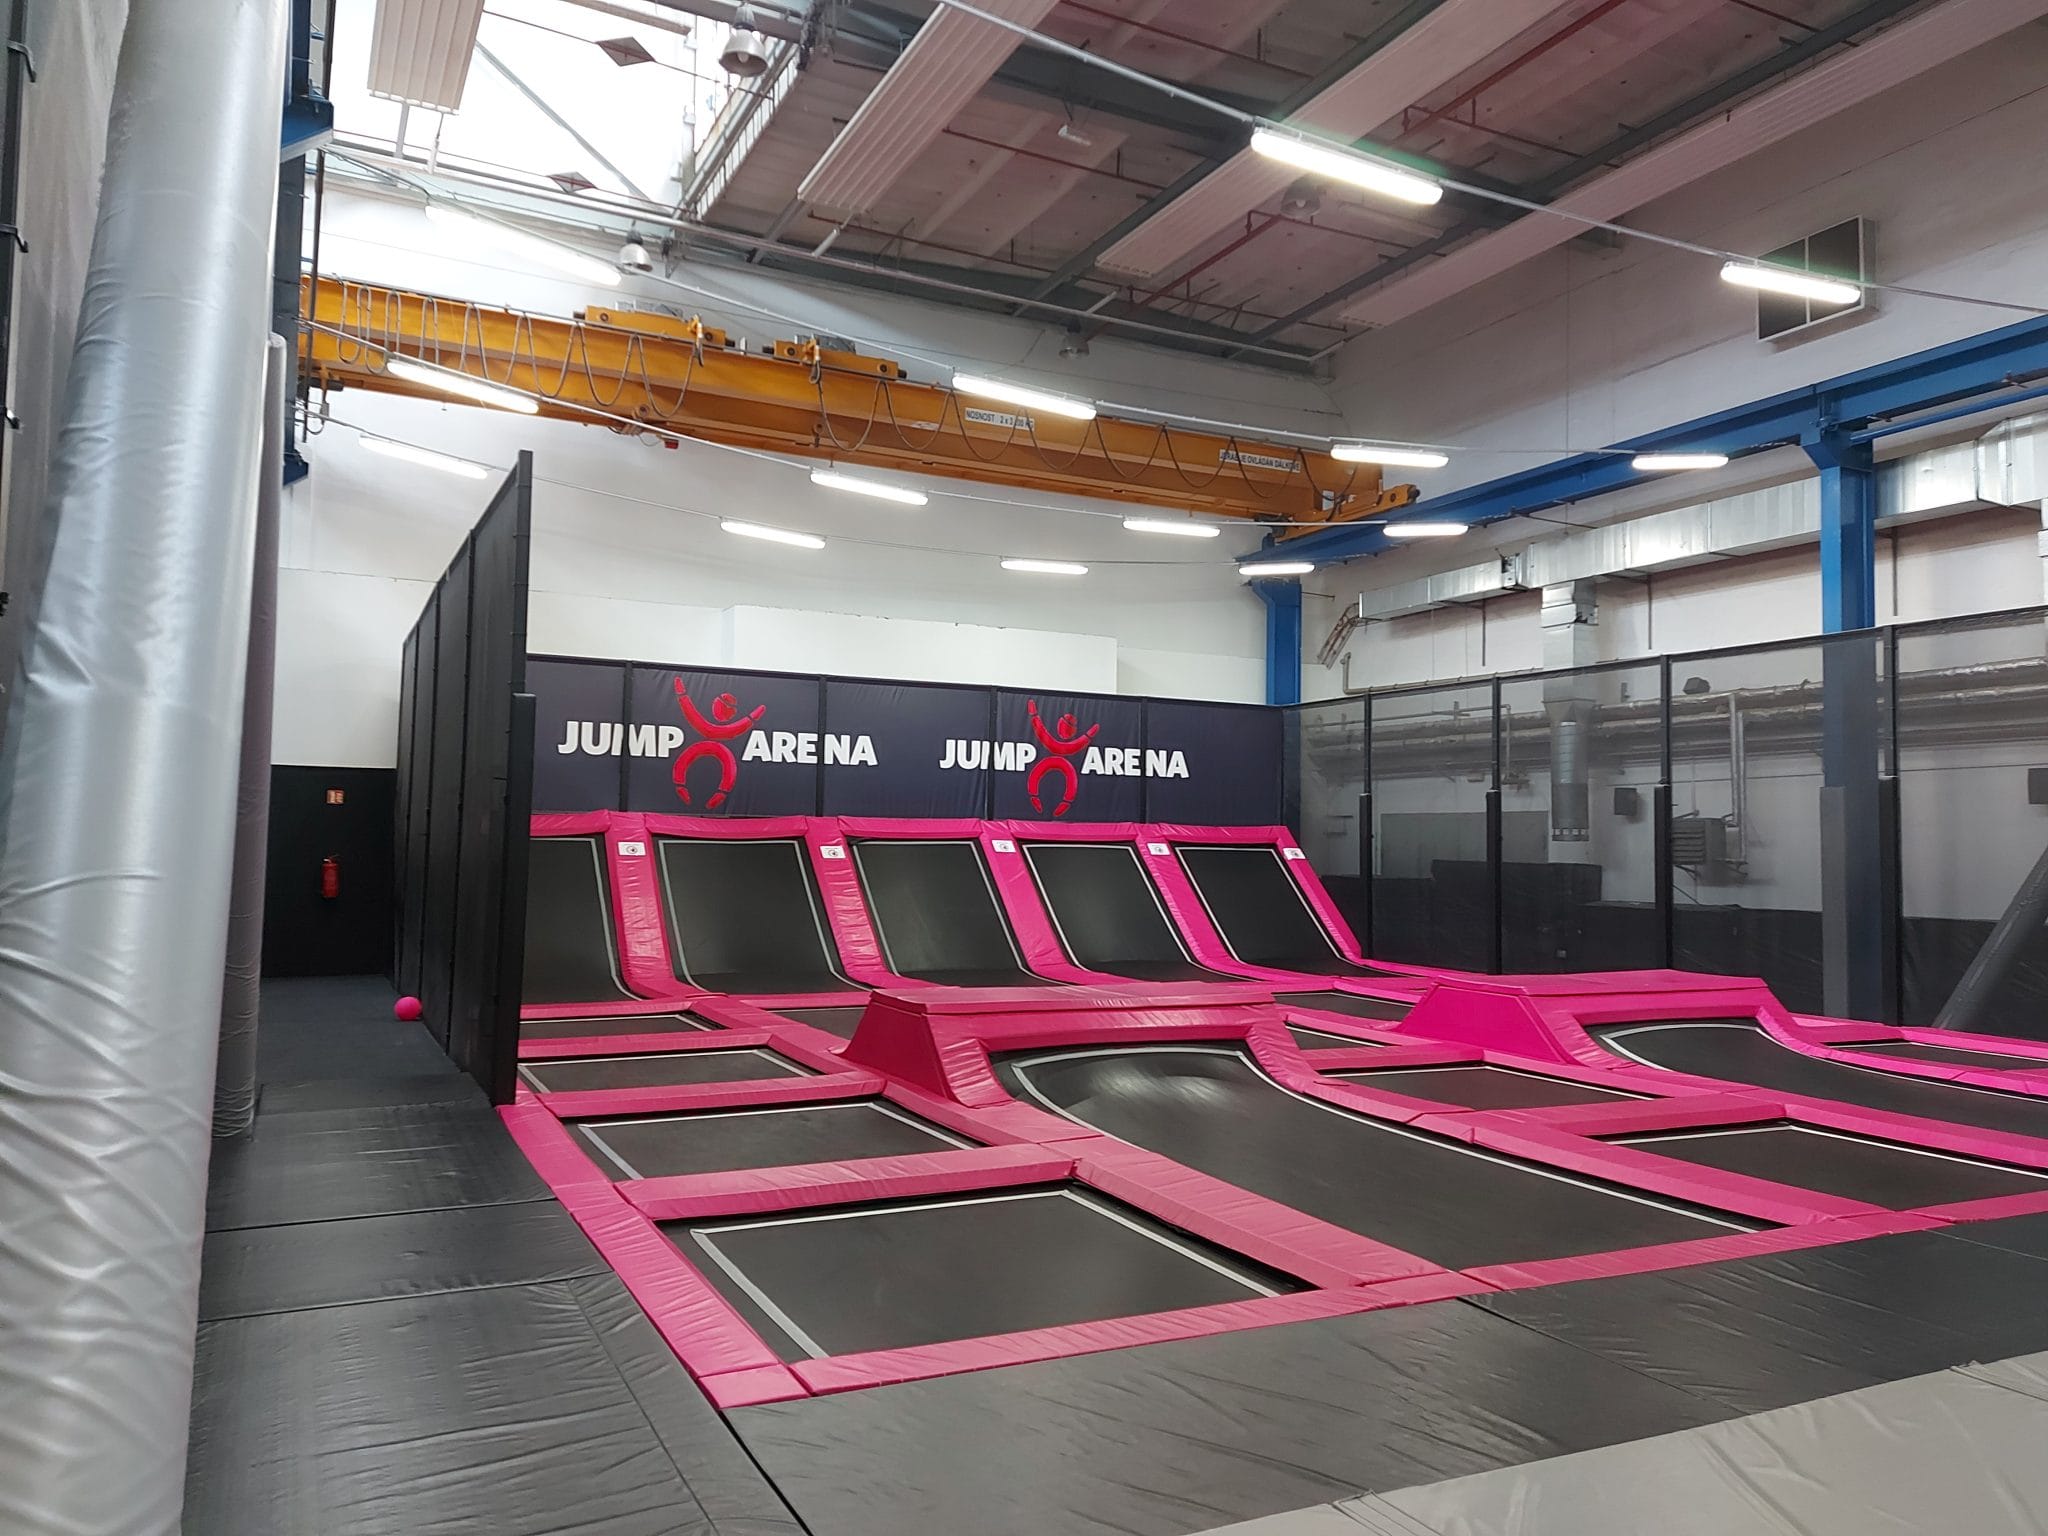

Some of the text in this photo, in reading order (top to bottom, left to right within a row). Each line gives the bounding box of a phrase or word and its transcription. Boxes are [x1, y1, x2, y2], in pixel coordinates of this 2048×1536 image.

[557, 720, 878, 766] JUMP ARENA
[939, 739, 1189, 779] JUMP ARENA
